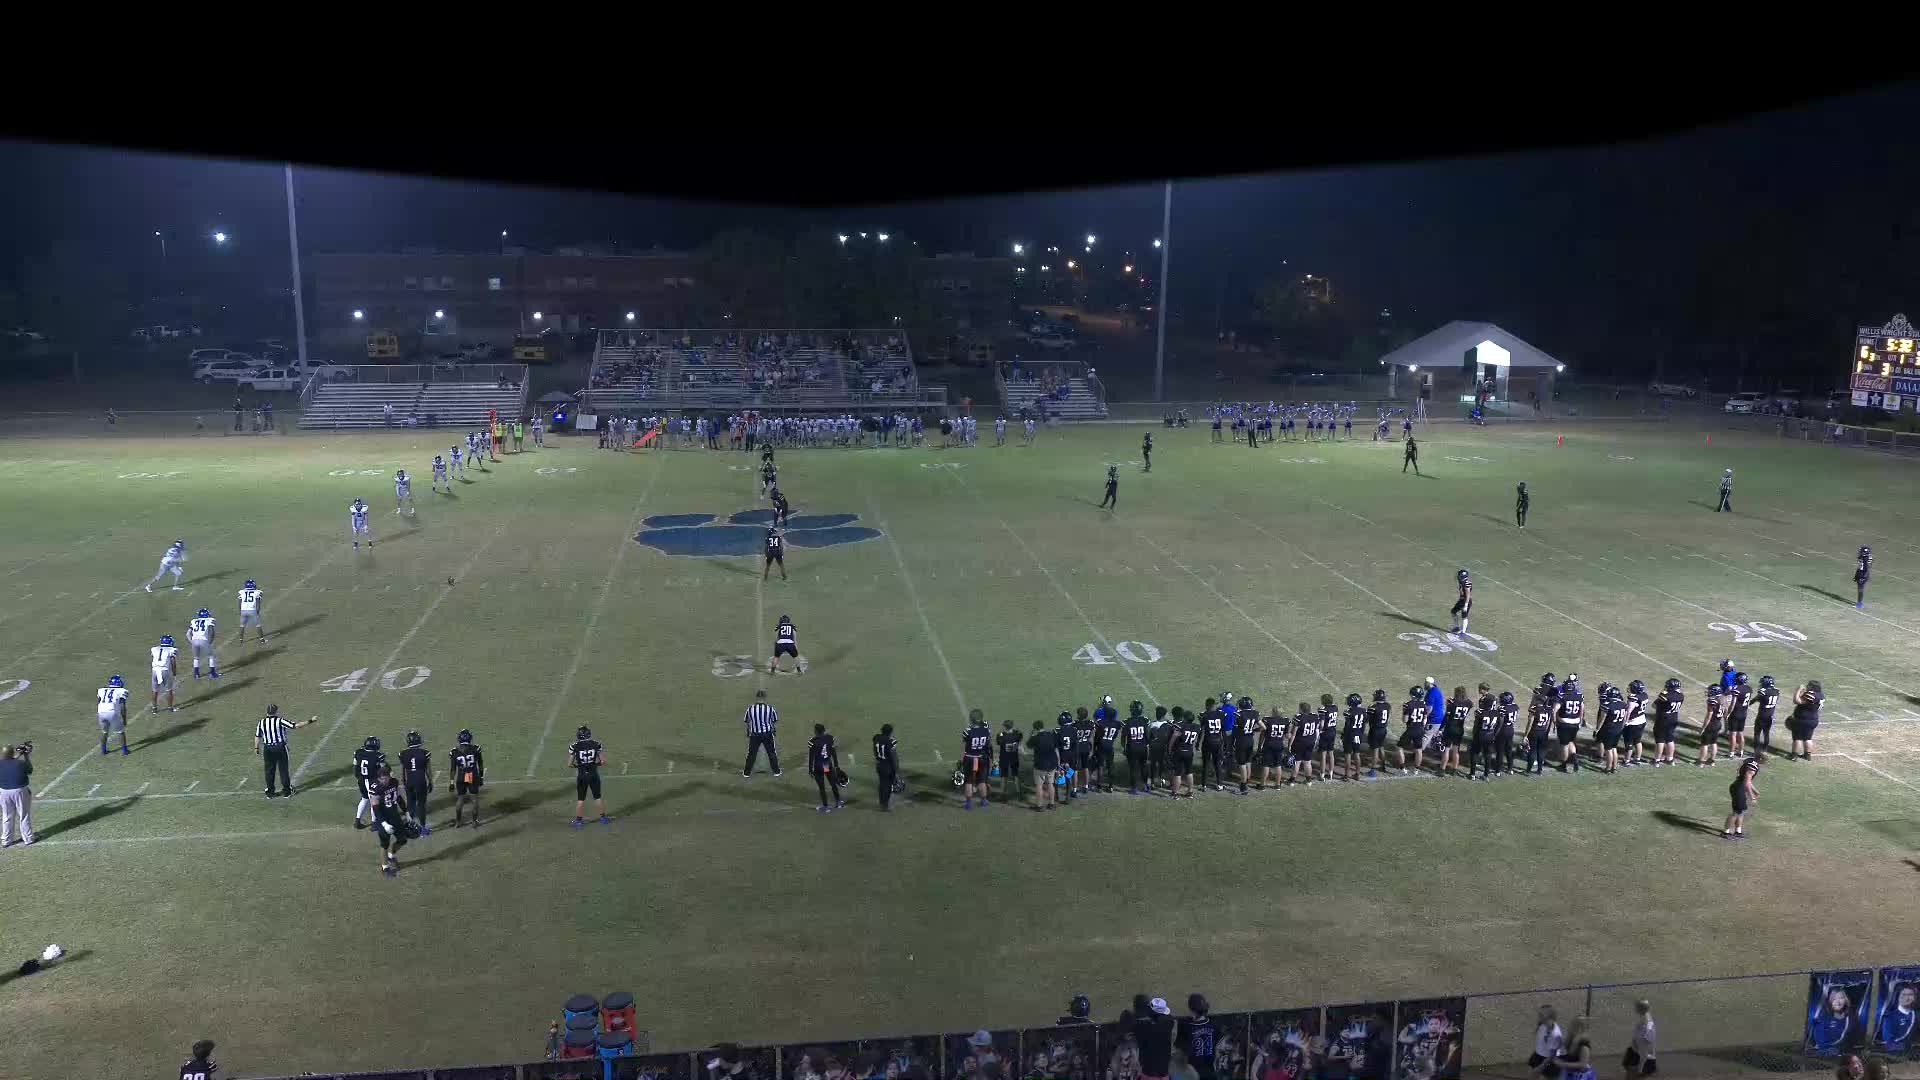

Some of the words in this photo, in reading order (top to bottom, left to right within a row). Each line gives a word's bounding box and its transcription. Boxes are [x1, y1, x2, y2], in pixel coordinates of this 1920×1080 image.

[768, 537, 779, 547] 34
[243, 591, 255, 603] 15
[193, 620, 206, 632] 34
[780, 625, 792, 636] 20
[1707, 621, 1808, 643] 20
[157, 647, 164, 662] 1
[1071, 640, 1162, 665] 40
[319, 666, 432, 693] 40
[102, 689, 114, 704] 14
[1352, 713, 1364, 729] 14
[1381, 709, 1388, 724] 9
[1411, 707, 1425, 723] 45
[1063, 736, 1071, 750] 3
[360, 759, 369, 776] 6
[410, 757, 417, 772] 1
